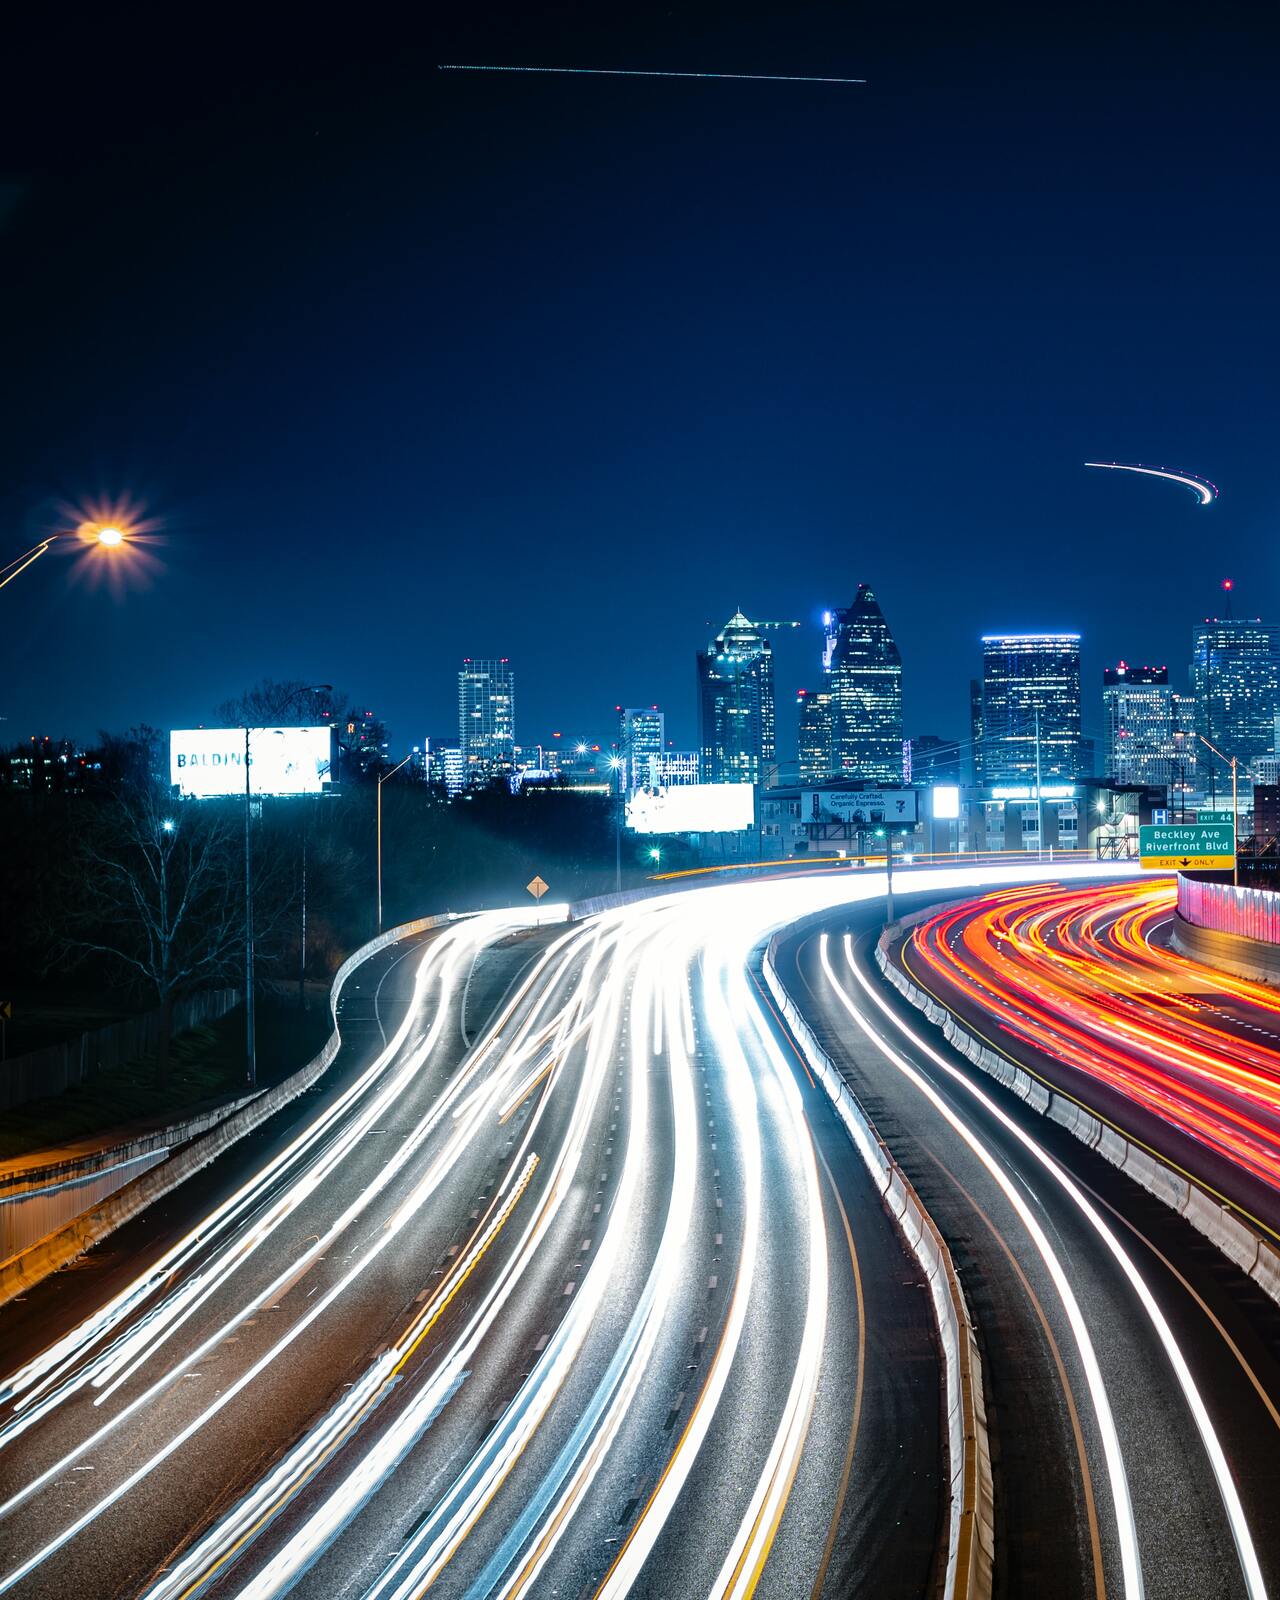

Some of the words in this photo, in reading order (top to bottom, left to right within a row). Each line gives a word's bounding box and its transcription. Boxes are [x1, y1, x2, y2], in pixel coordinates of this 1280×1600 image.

[177, 752, 254, 768] BALDING
[830, 793, 858, 801] Carefully
[1154, 810, 1166, 824] H
[1154, 831, 1196, 840] Beckley
[1201, 831, 1220, 839] Ave
[1146, 842, 1200, 851] Riverfront
[1205, 842, 1229, 850] Blvd
